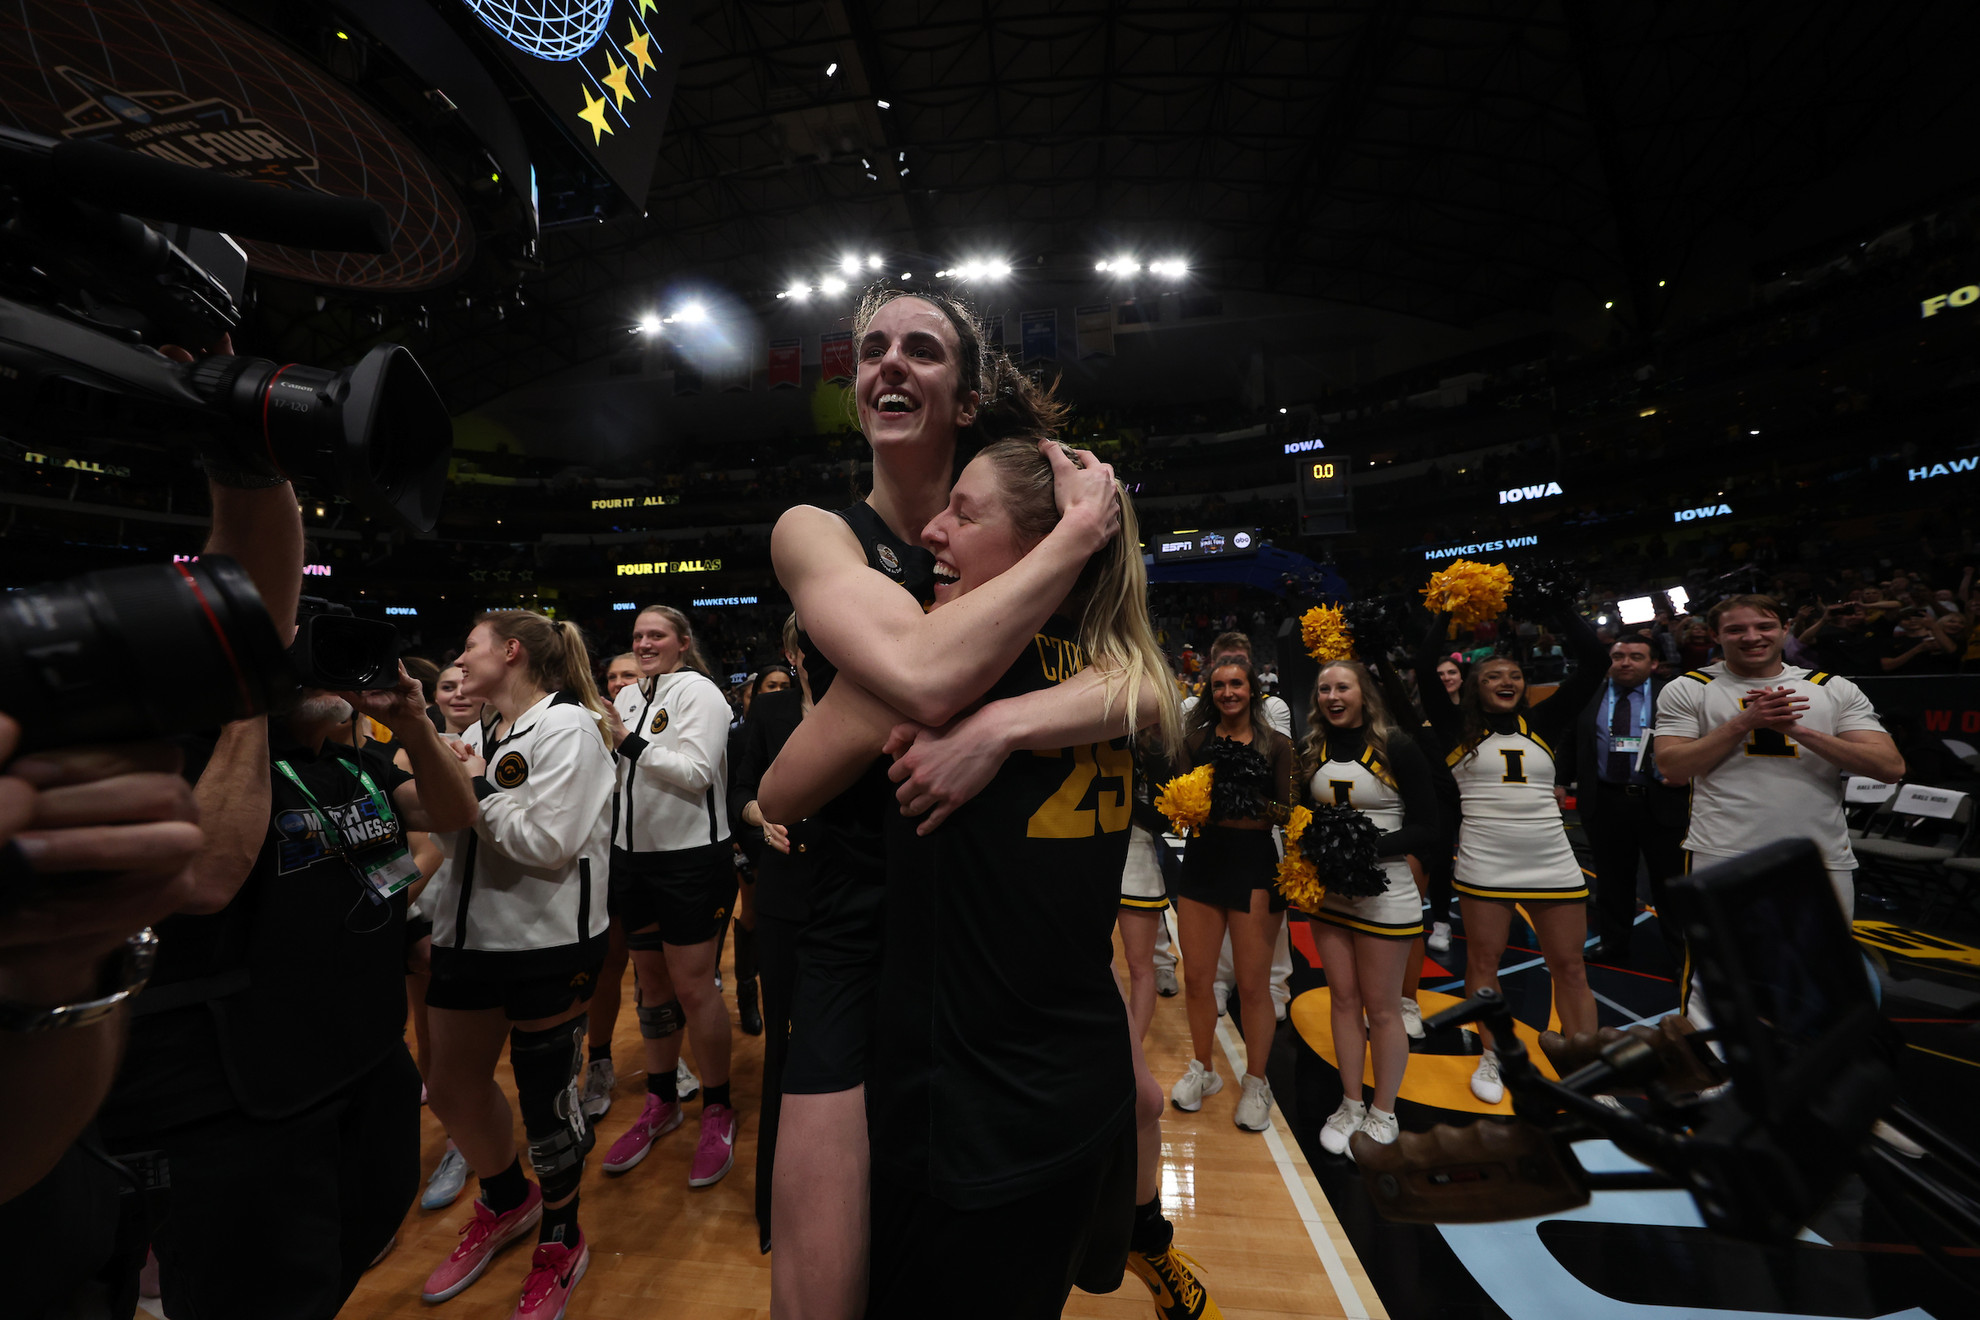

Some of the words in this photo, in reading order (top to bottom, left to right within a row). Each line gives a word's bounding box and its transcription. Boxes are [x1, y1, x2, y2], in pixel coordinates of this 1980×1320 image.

[181, 129, 302, 165] FOUR
[280, 380, 314, 393] Canon
[273, 399, 309, 414] 17-120
[1284, 438, 1325, 454] IOWA
[1499, 481, 1564, 504] IOWA
[591, 497, 623, 510] FOUR
[623, 498, 635, 508] IT
[1673, 503, 1733, 523] IOWA
[1161, 541, 1192, 553] ESPN
[1425, 539, 1504, 561] HAWKEYES
[1506, 535, 1539, 550] WIN
[616, 563, 654, 576] FOUR
[653, 562, 669, 574] IT
[612, 602, 637, 611] IOWA
[692, 597, 740, 608] HAWKEYES
[740, 596, 758, 605] WIN
[385, 606, 418, 617] IOWA
[1034, 632, 1085, 683] CZIN
[1500, 749, 1527, 784] I
[1026, 739, 1134, 839] 25
[1911, 793, 1928, 802] BALL
